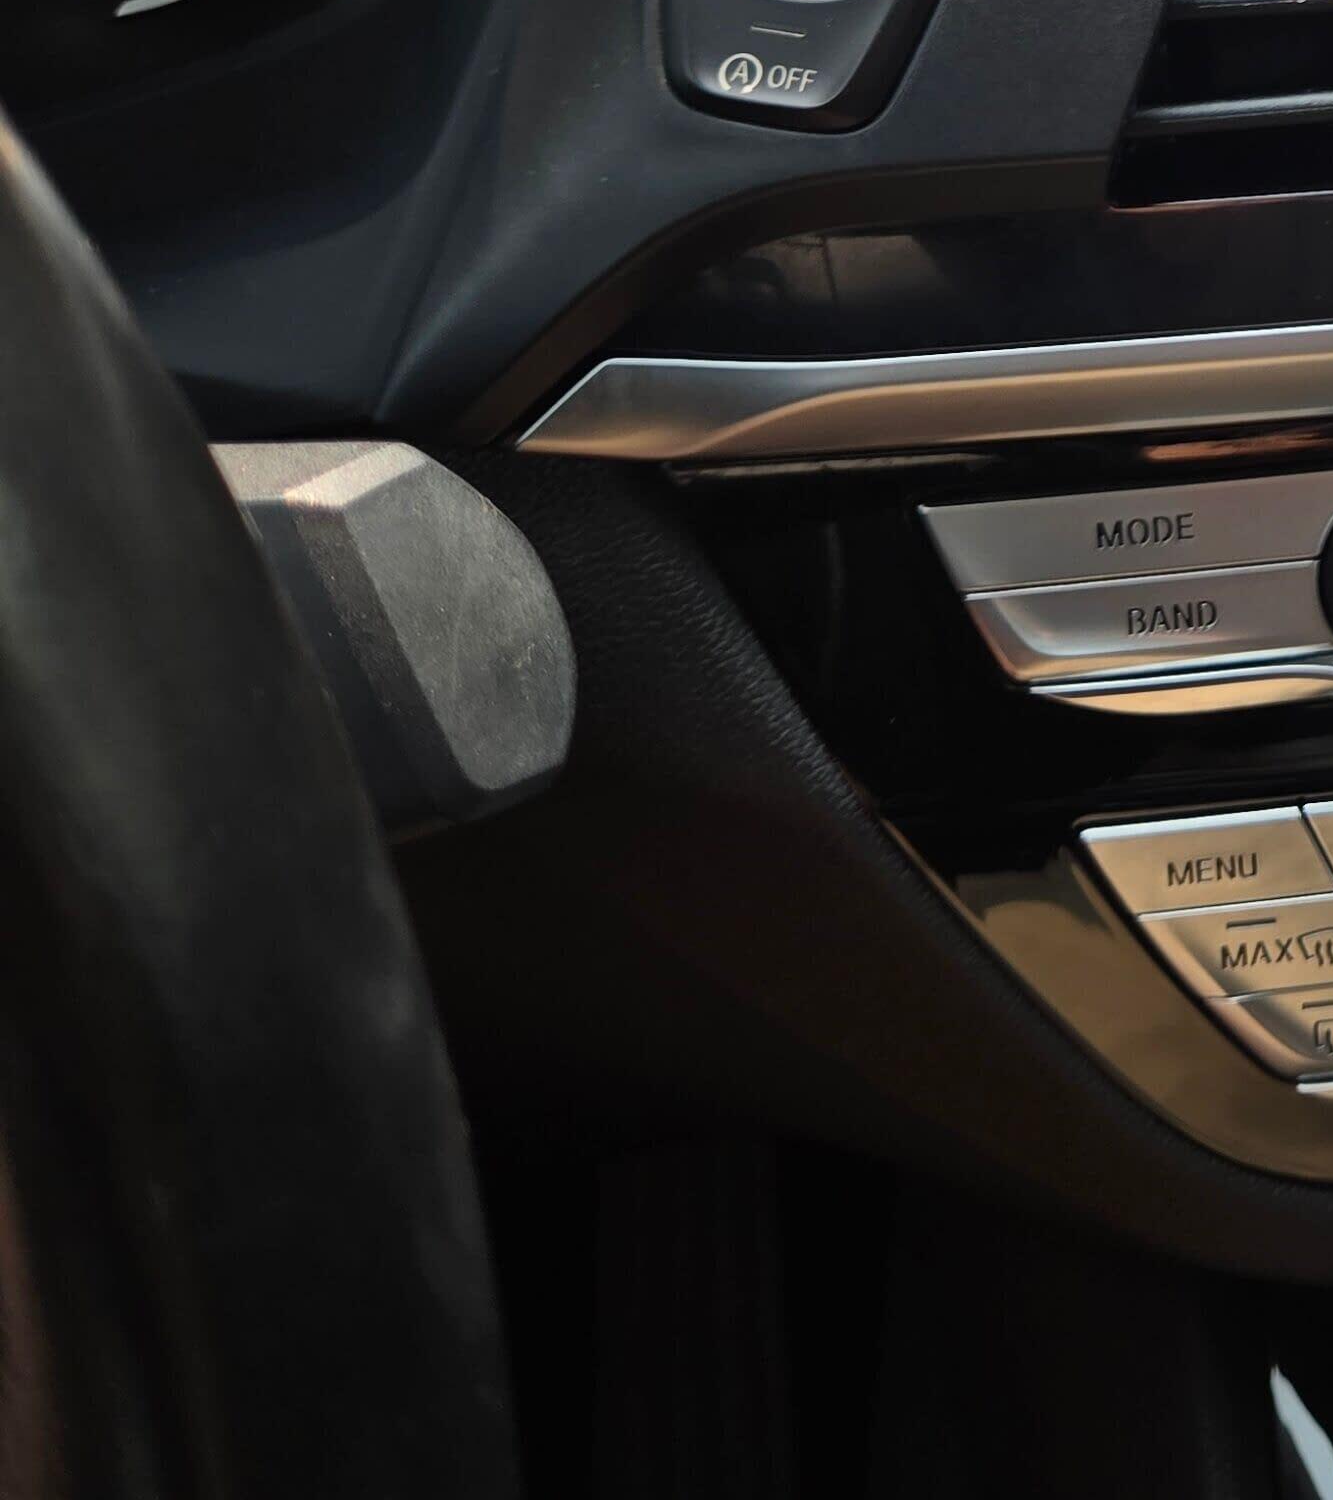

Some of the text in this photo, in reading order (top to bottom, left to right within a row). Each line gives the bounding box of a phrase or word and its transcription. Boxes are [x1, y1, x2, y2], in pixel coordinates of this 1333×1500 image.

[767, 63, 818, 93] OFF
[1095, 513, 1196, 550] MODE
[1126, 601, 1219, 637] BAND
[1166, 853, 1259, 887] MENU
[1219, 937, 1295, 971] MAX
